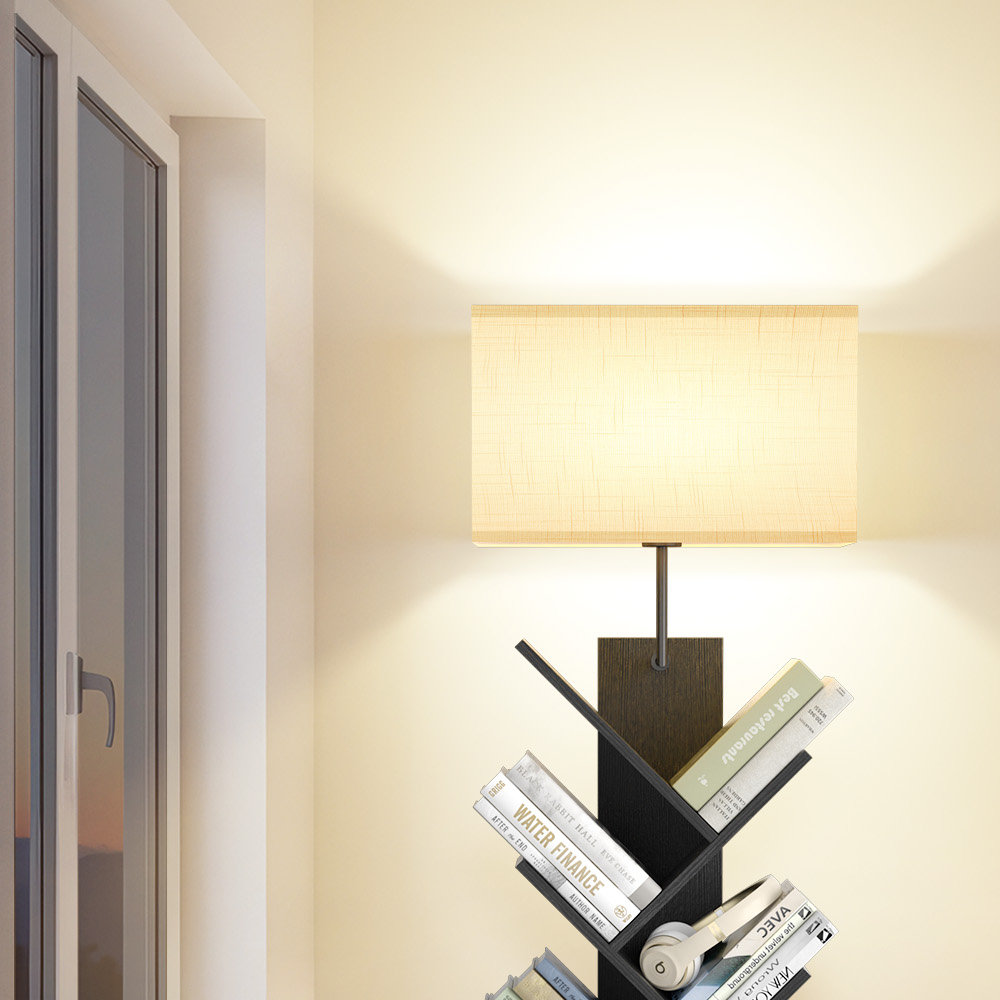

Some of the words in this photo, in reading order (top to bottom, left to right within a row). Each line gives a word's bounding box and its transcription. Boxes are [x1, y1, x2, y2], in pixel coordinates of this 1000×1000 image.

[773, 686, 801, 714] Best
[719, 708, 778, 767] restaurants
[488, 780, 506, 798] GRIGG
[491, 815, 509, 833] AFTER
[514, 839, 528, 852] END
[511, 803, 557, 849] WATER
[549, 842, 606, 897] FINANCE
[574, 824, 599, 848] HALL
[600, 849, 615, 864] EVE
[613, 863, 636, 885] CHASE
[569, 893, 590, 914] AUTHOR
[589, 913, 606, 930] NAME
[551, 976, 571, 995] AFTER
